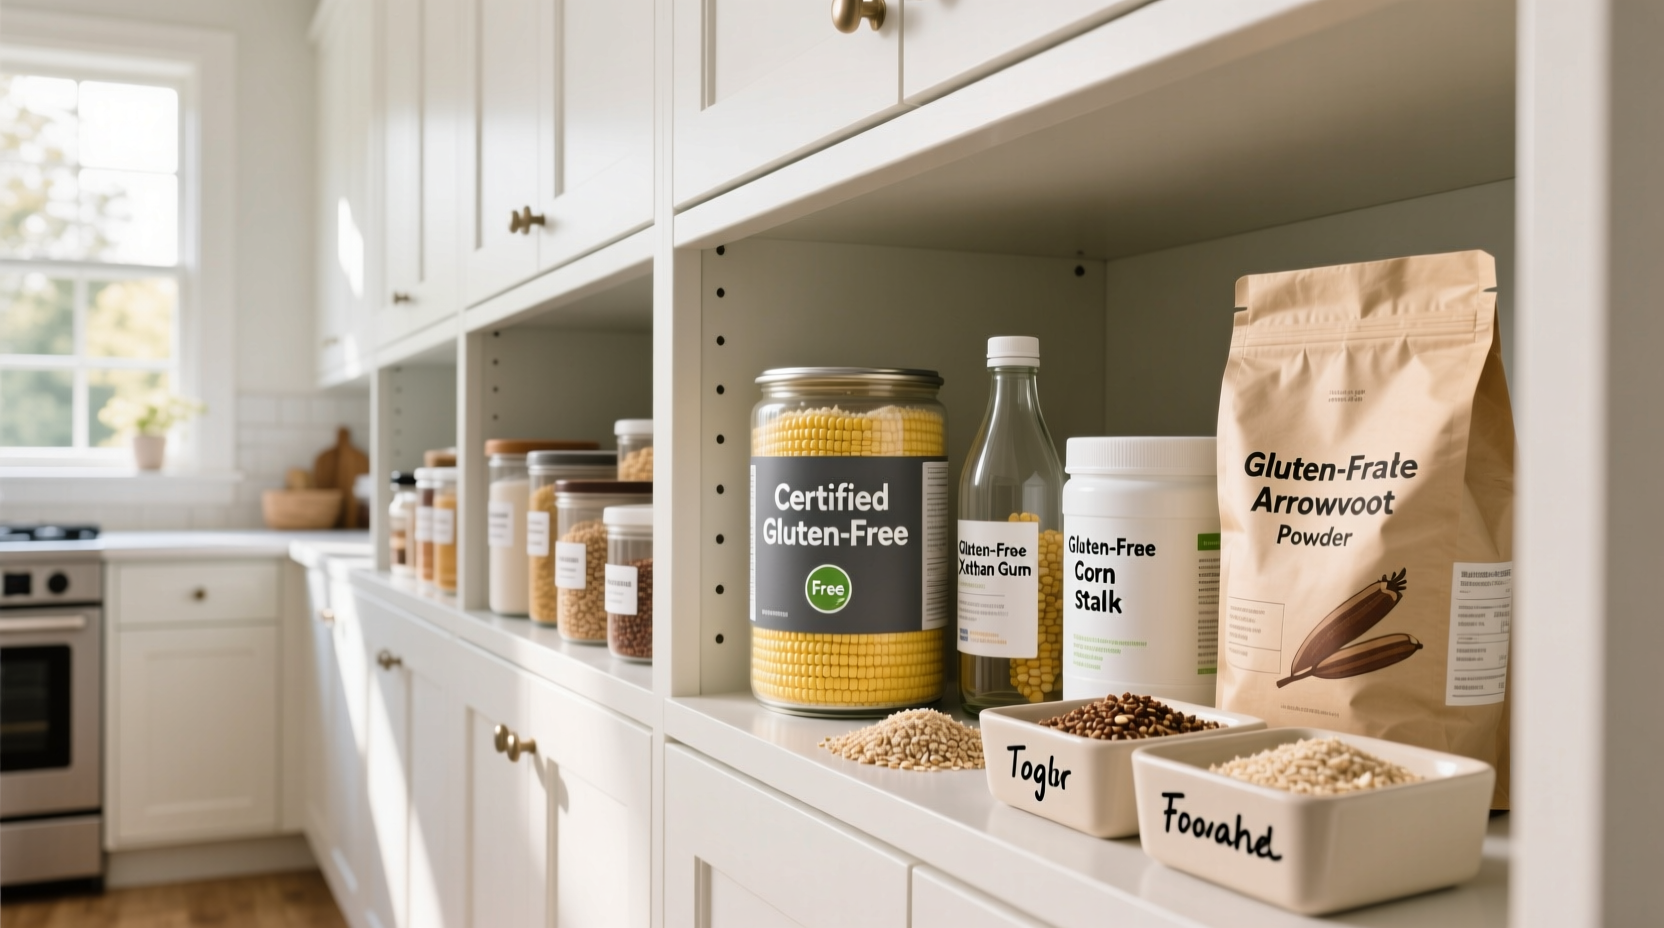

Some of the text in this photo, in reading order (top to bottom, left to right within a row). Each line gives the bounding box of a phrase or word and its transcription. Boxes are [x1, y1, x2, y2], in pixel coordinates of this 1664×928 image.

[774, 482, 889, 512] Certified
[762, 517, 909, 547] Gluten-Free
[1276, 523, 1353, 547] Powder
[1068, 535, 1157, 557] Gluten-Free
[997, 561, 1032, 577] Gum
[1074, 559, 1116, 585] Corn
[811, 579, 845, 596] Free
[1075, 589, 1123, 614] Stalk
